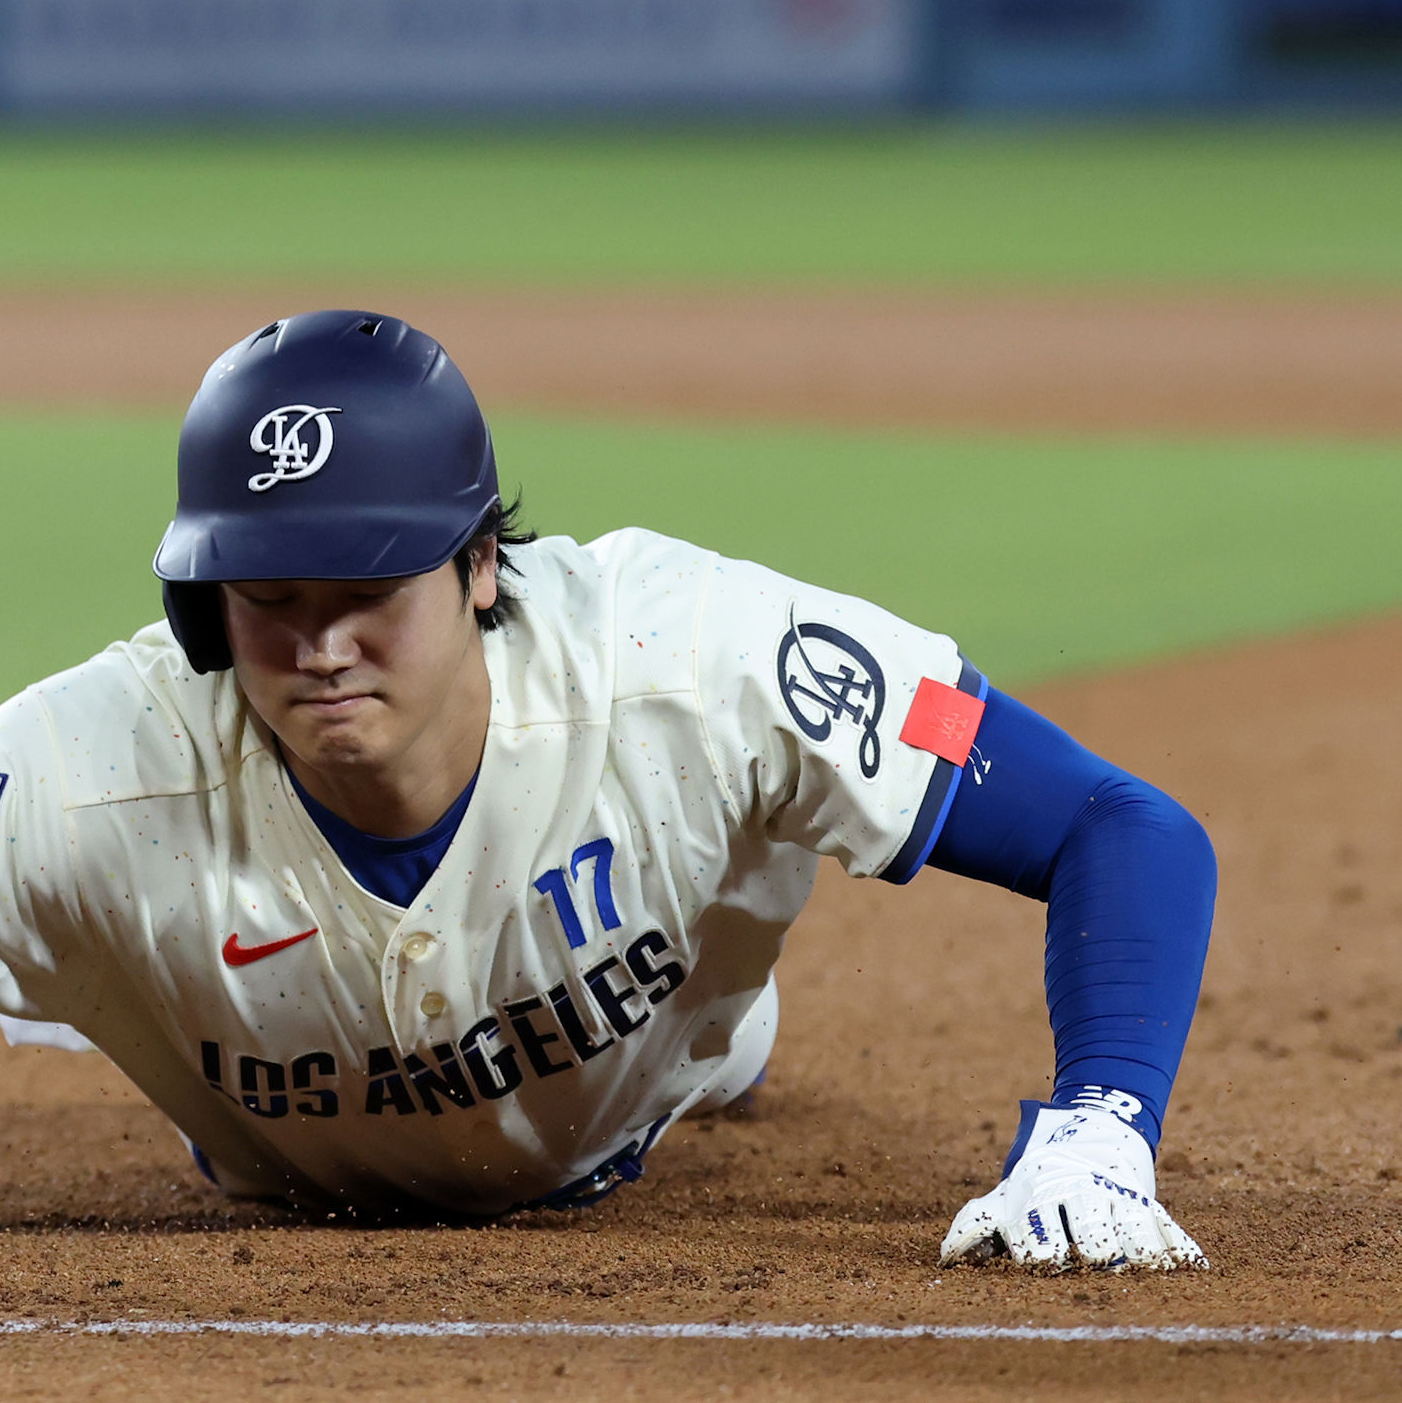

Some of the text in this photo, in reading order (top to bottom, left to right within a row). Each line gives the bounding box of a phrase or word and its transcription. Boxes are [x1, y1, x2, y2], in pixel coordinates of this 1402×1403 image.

[533, 837, 622, 950] 17
[201, 929, 687, 1118] LOS ANGELES
